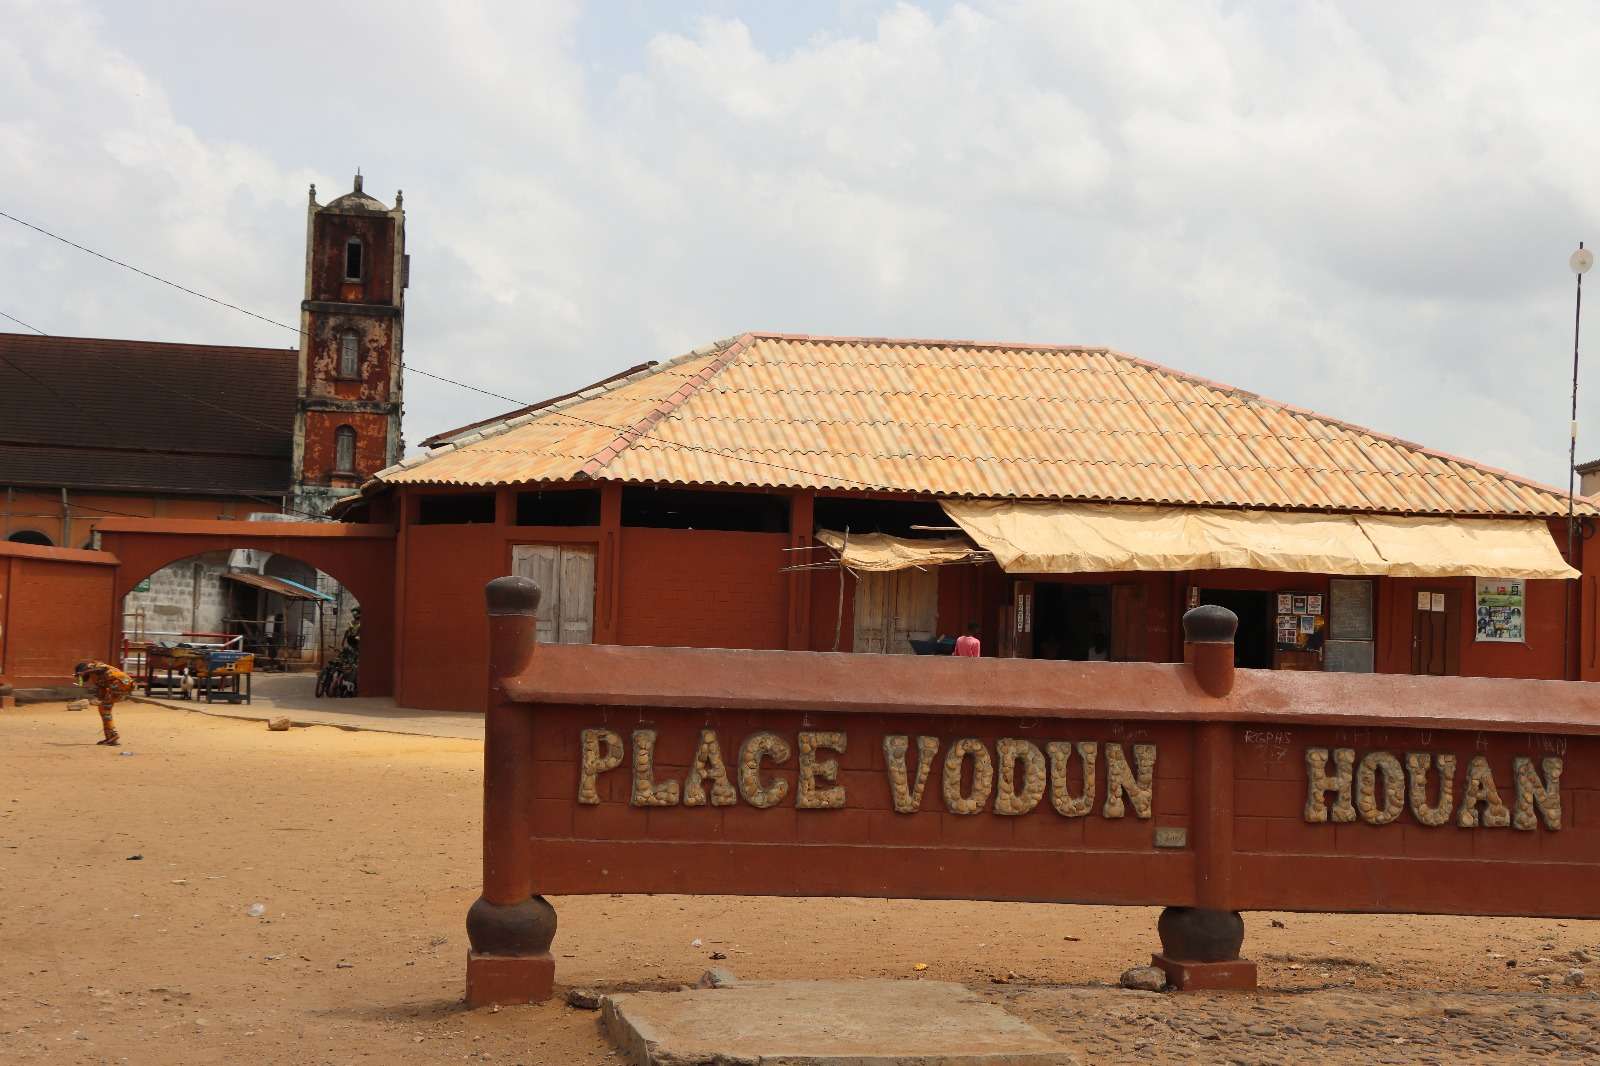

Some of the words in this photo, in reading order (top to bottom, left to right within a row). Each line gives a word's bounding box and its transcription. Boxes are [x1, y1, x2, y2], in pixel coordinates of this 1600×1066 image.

[577, 728, 847, 808] PLACE
[883, 734, 1156, 817] VODUN
[1305, 748, 1562, 830] HOUAN
